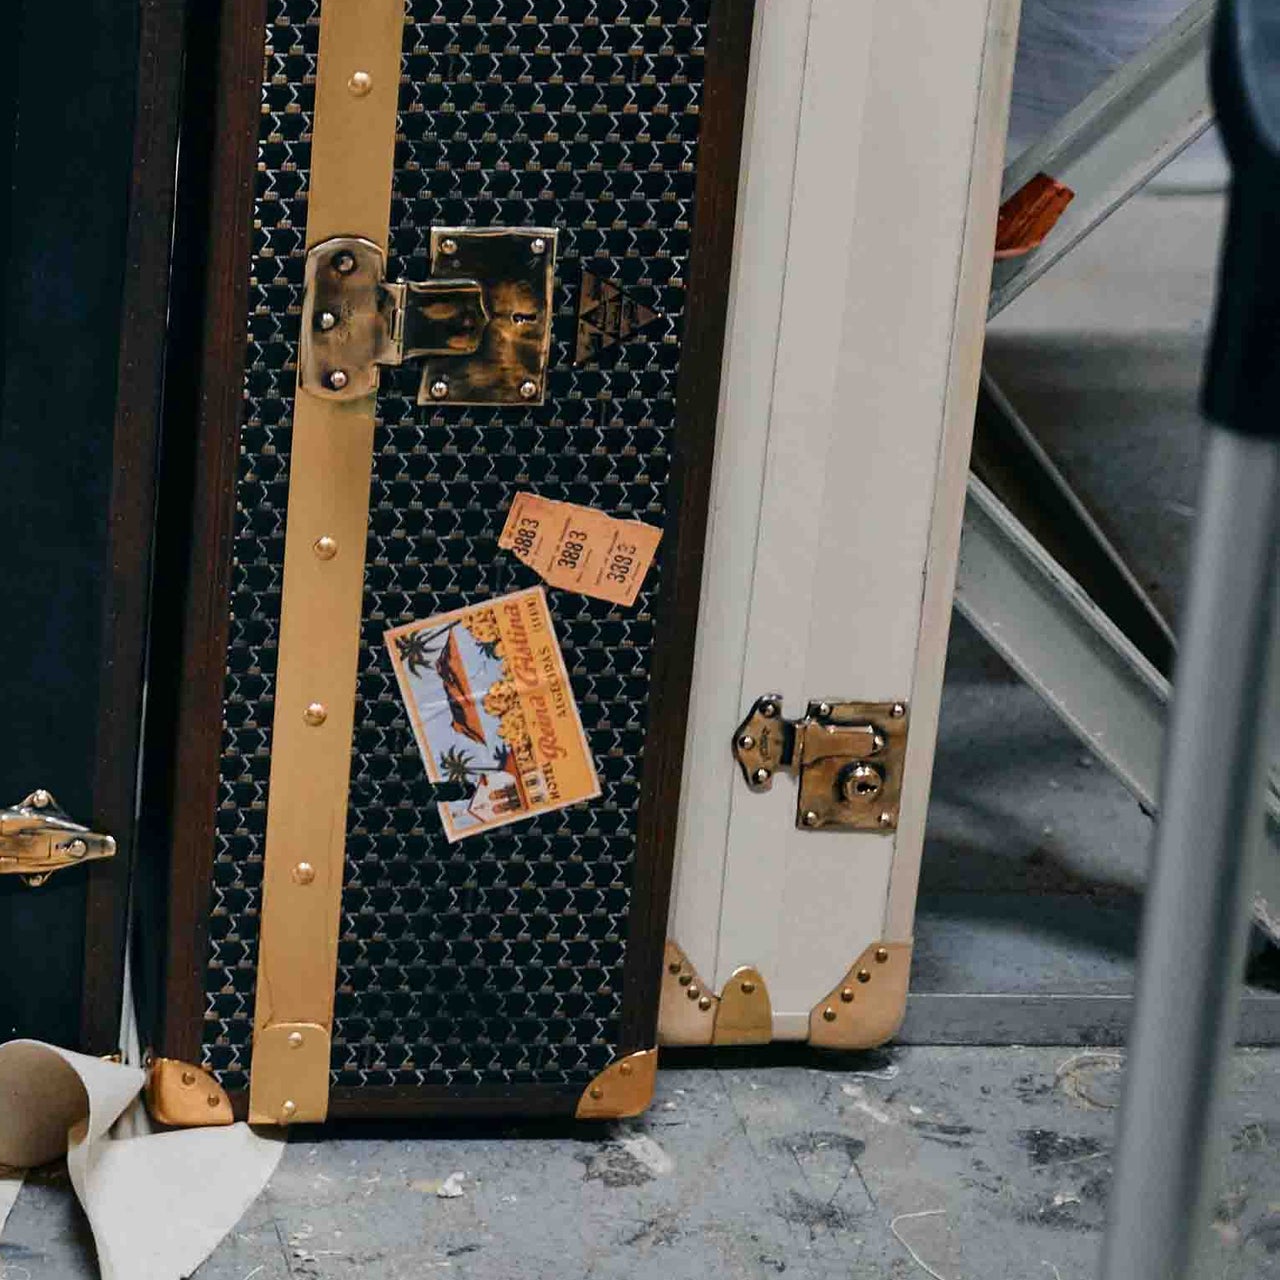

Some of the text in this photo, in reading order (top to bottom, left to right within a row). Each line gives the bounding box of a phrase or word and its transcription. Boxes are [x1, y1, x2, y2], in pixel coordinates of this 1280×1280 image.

[512, 517, 540, 557] 3883
[557, 529, 588, 570] 3883
[503, 600, 568, 801] HOTEL Reina Cristina
[539, 646, 568, 719] ALGECIRAS
